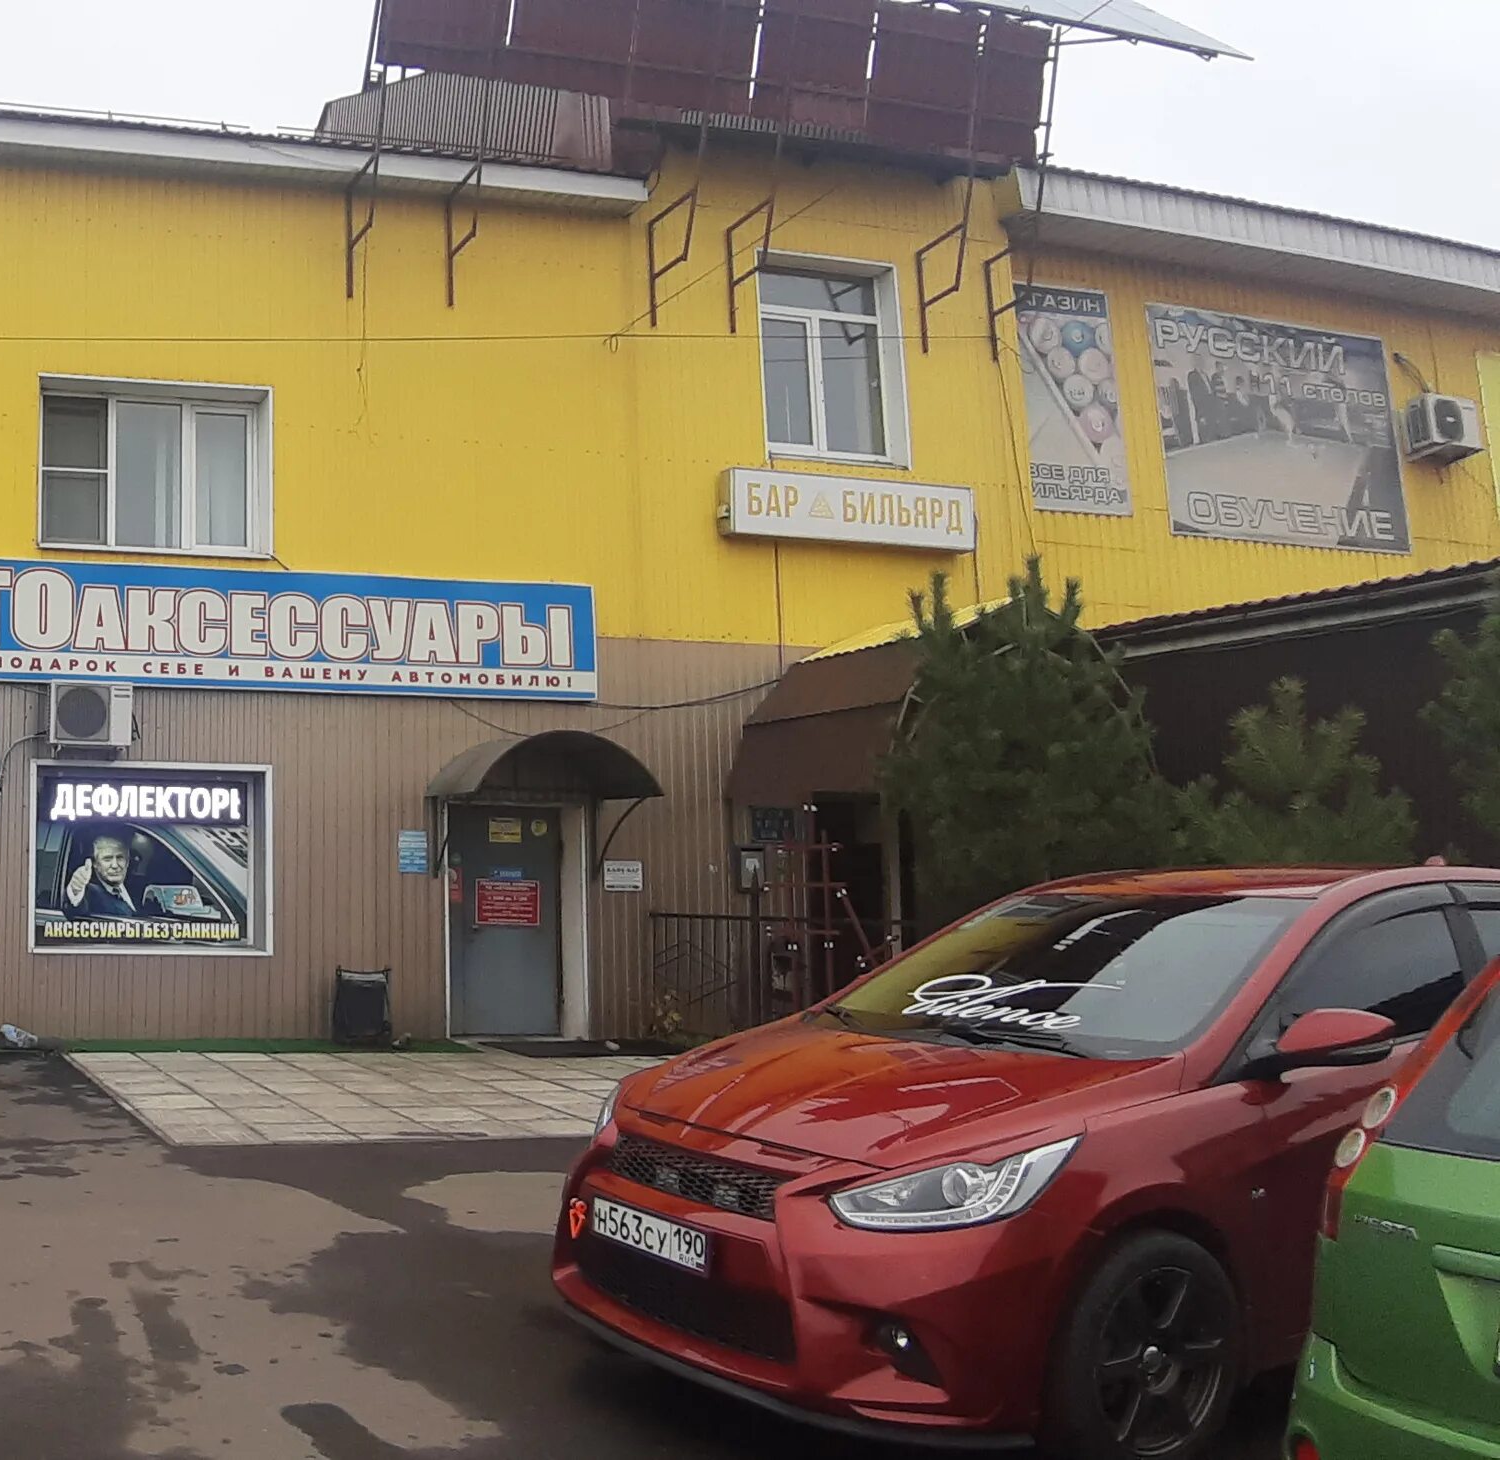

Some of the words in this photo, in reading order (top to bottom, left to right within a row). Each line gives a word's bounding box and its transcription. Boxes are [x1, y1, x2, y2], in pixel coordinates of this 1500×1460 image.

[1153, 318, 1346, 376] РУССКИЙ
[1030, 462, 1065, 480] ВСЕ
[1068, 466, 1111, 484] ДЛЯ
[746, 482, 799, 518] БАР
[842, 490, 965, 536] БИЛЬЯРД
[1186, 490, 1396, 541] ОБУЧЕНИЕ
[143, 661, 204, 676] СЕБЕ
[228, 664, 240, 677] И
[264, 666, 368, 681] ВАШЕМУ
[391, 671, 573, 688] АВТОМОБИЛЮ!
[44, 921, 141, 939] АКСЕССУАРЫ
[143, 922, 170, 939] БЕЗ
[172, 921, 240, 940] САНКЦИЙ
[596, 1205, 668, 1254] Н563СУ
[673, 1227, 705, 1258] 190
[678, 1254, 695, 1267] RUS
